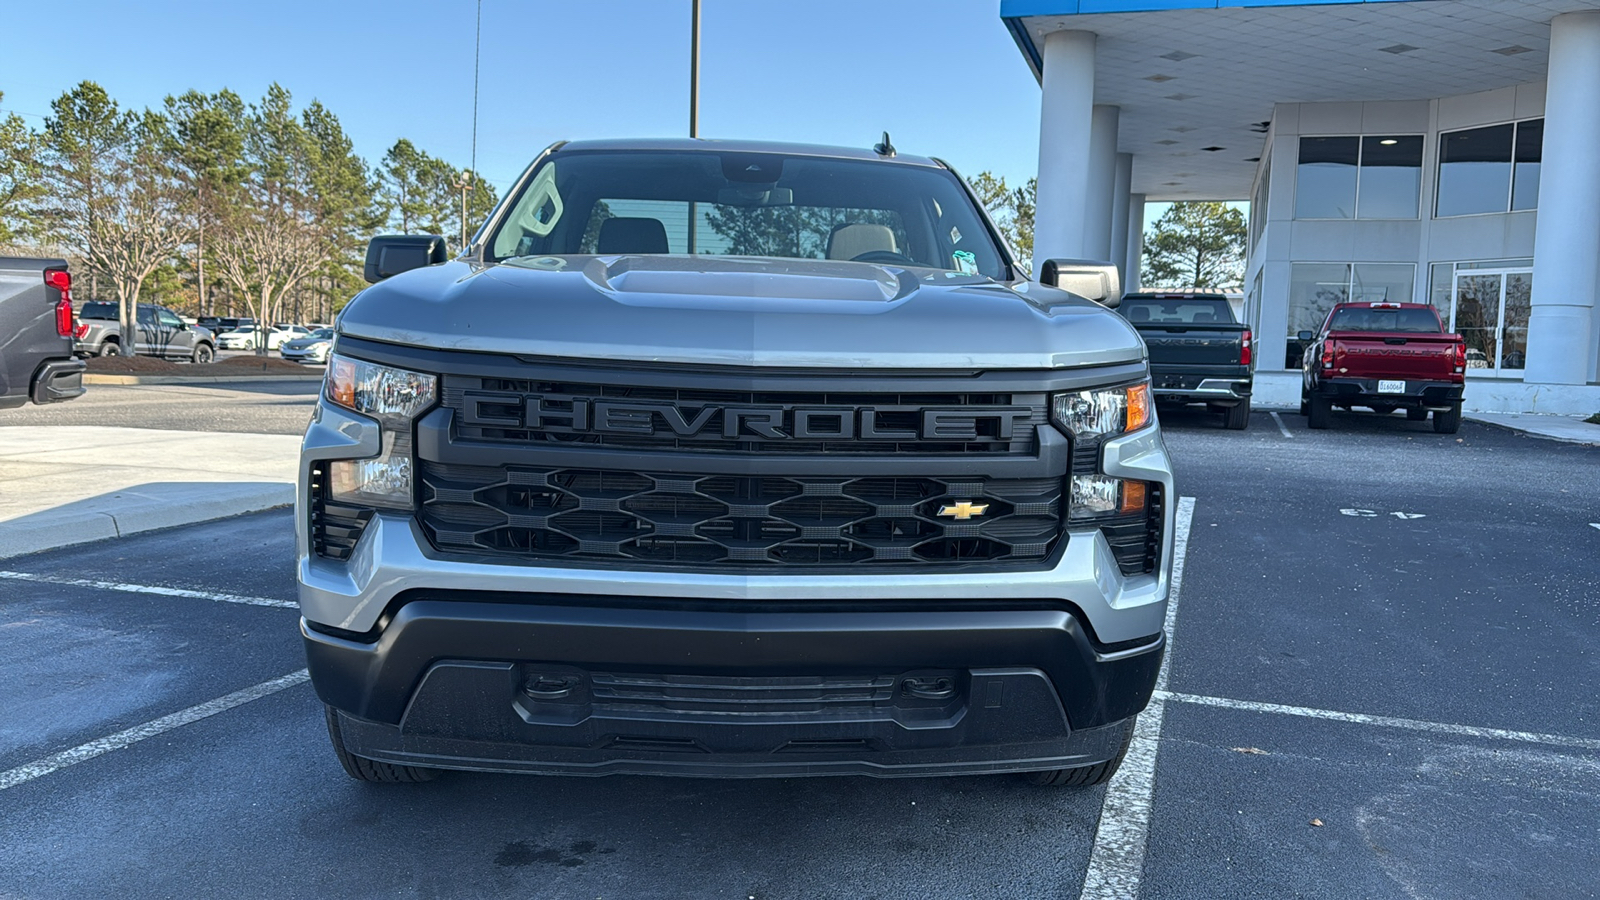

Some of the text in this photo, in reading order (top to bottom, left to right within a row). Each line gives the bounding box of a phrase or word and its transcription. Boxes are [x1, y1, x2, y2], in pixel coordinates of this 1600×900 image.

[1145, 338, 1234, 347] EVROLET
[1347, 348, 1443, 357] CHEVROLET
[463, 391, 1032, 441] CHEVROLET
